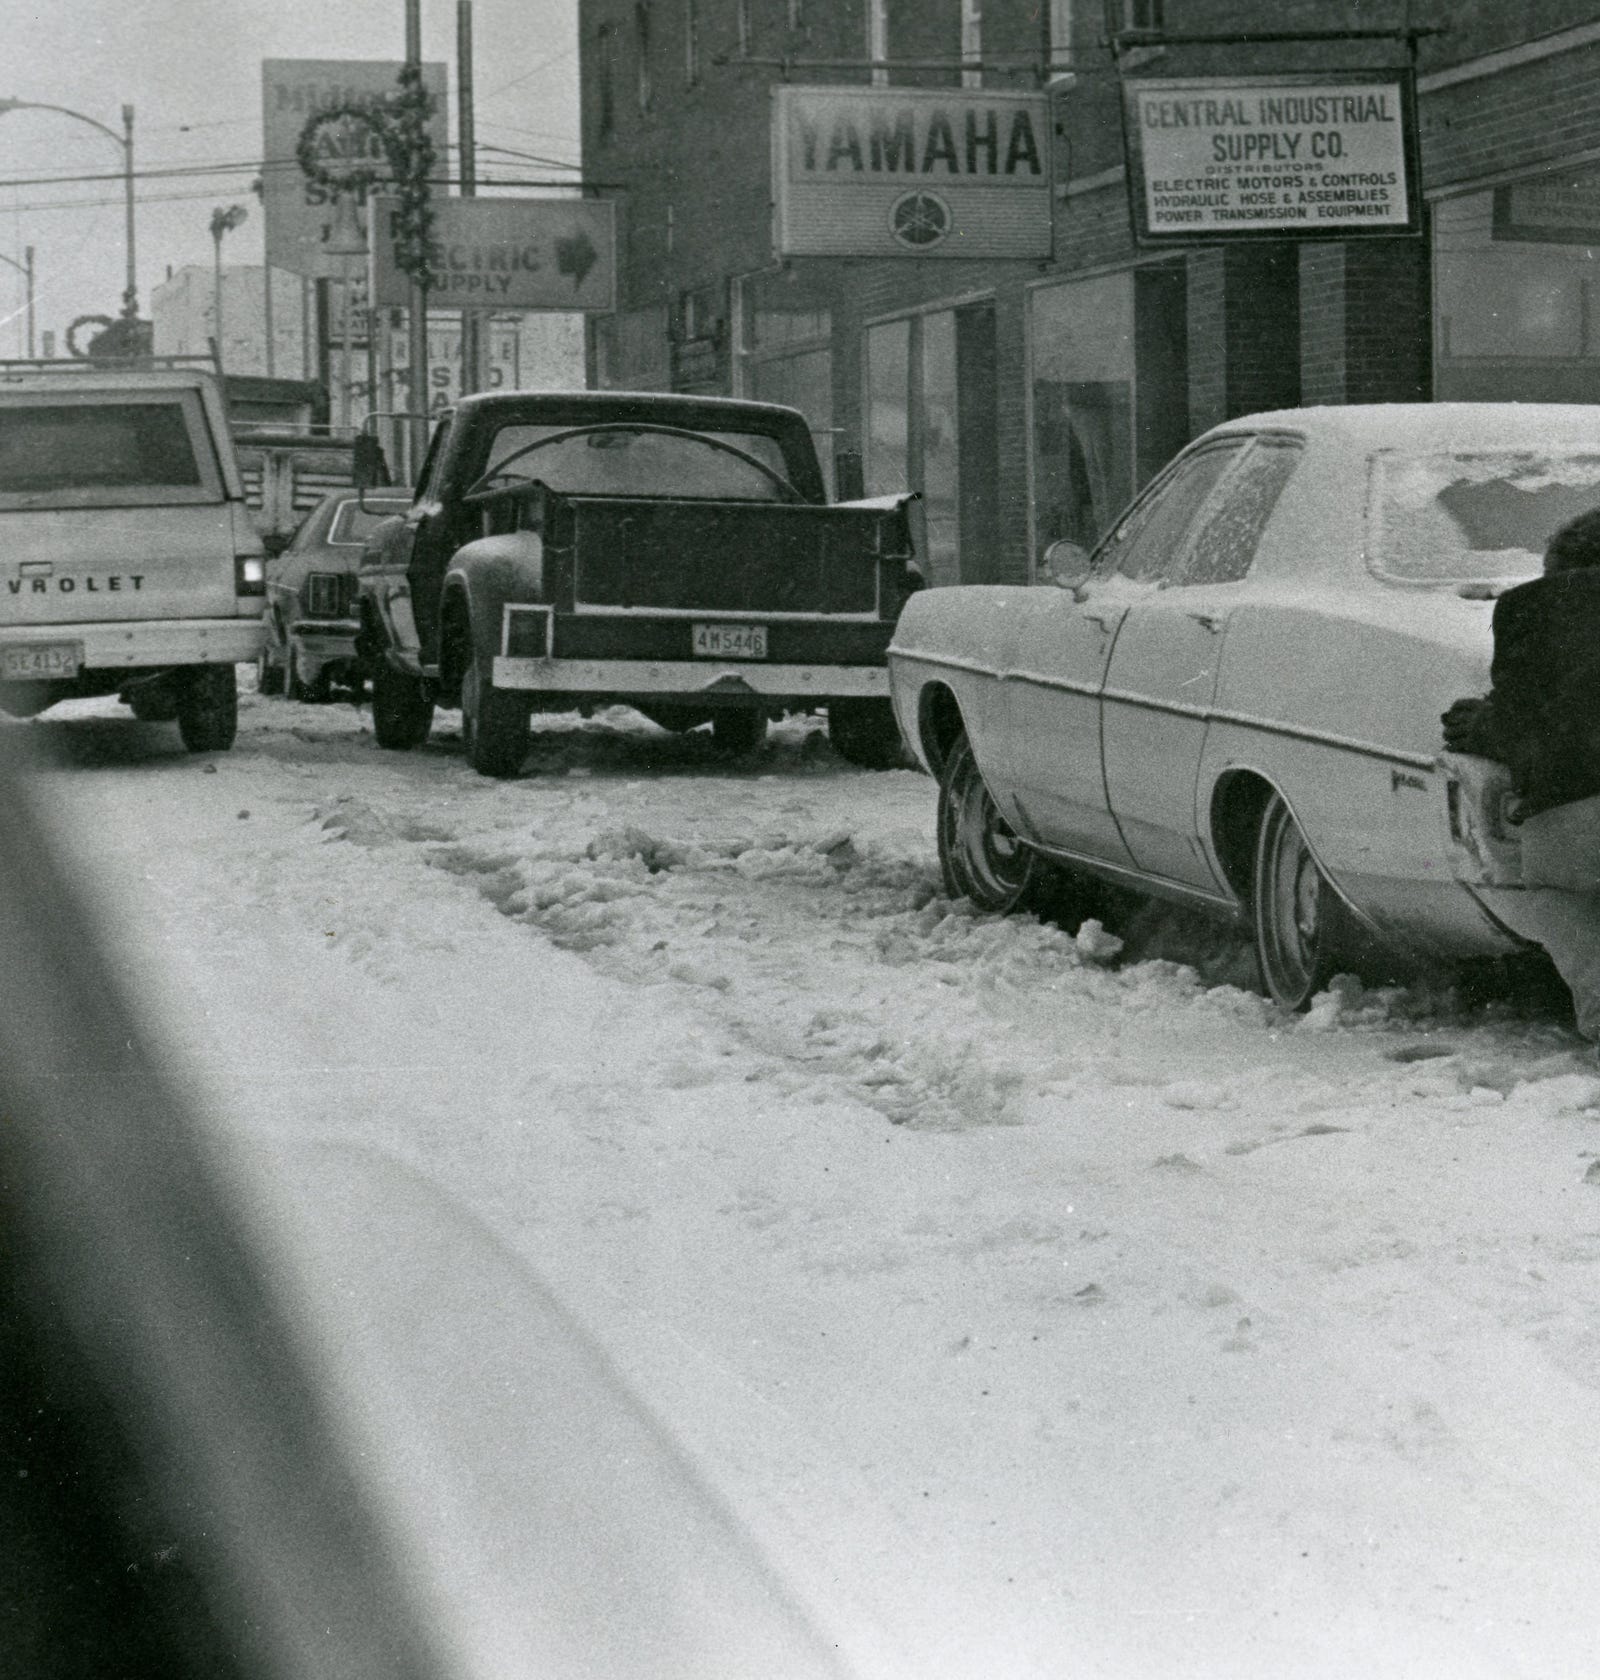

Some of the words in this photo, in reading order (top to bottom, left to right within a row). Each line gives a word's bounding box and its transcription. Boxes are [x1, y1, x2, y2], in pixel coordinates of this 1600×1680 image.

[1145, 99, 1250, 128] CENTRAL
[1260, 95, 1394, 124] INDUSTRIAL
[797, 109, 1041, 175] YAMAHA
[1212, 133, 1302, 161] SUPPLY
[1312, 131, 1348, 158] CO.
[1206, 163, 1323, 174] DISTRIBUTORS
[1153, 178, 1230, 191] ELECTRIC
[1237, 176, 1303, 189] MOTORS
[1309, 176, 1317, 187] &
[1322, 173, 1397, 186] CONTROLS
[1154, 194, 1230, 207] HYDRAULIC
[1241, 192, 1276, 204] HOSE
[1299, 189, 1388, 202] ASSEMBLIES
[1156, 210, 1202, 222] POWER
[1213, 207, 1306, 220] TRANSMISSION
[1318, 204, 1391, 218] EQUIPMENT
[413, 274, 512, 293] UPPLY
[8, 576, 144, 593] VROLET
